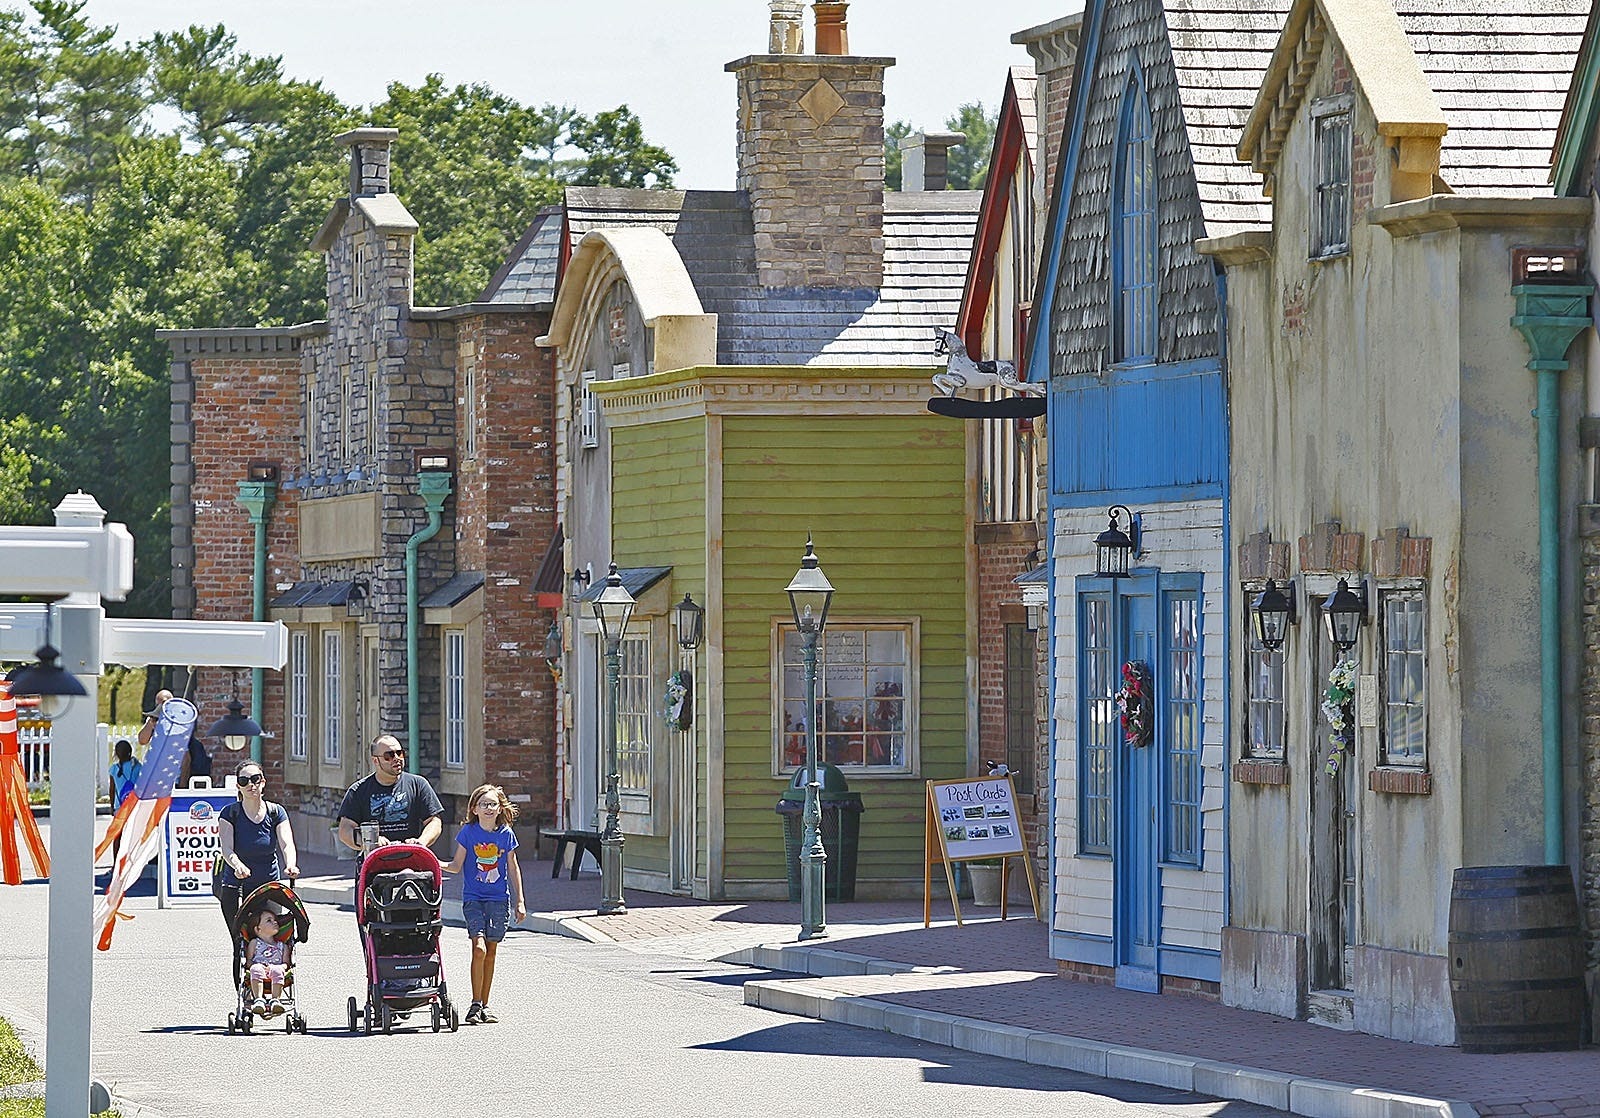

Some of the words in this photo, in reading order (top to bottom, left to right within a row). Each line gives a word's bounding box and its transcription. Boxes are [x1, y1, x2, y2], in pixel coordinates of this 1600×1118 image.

[945, 785, 973, 802] Post
[975, 782, 1007, 802] Cards
[176, 826, 207, 834] PICK
[211, 826, 219, 834] U
[177, 850, 221, 858] PHOTO
[178, 861, 213, 872] HER
